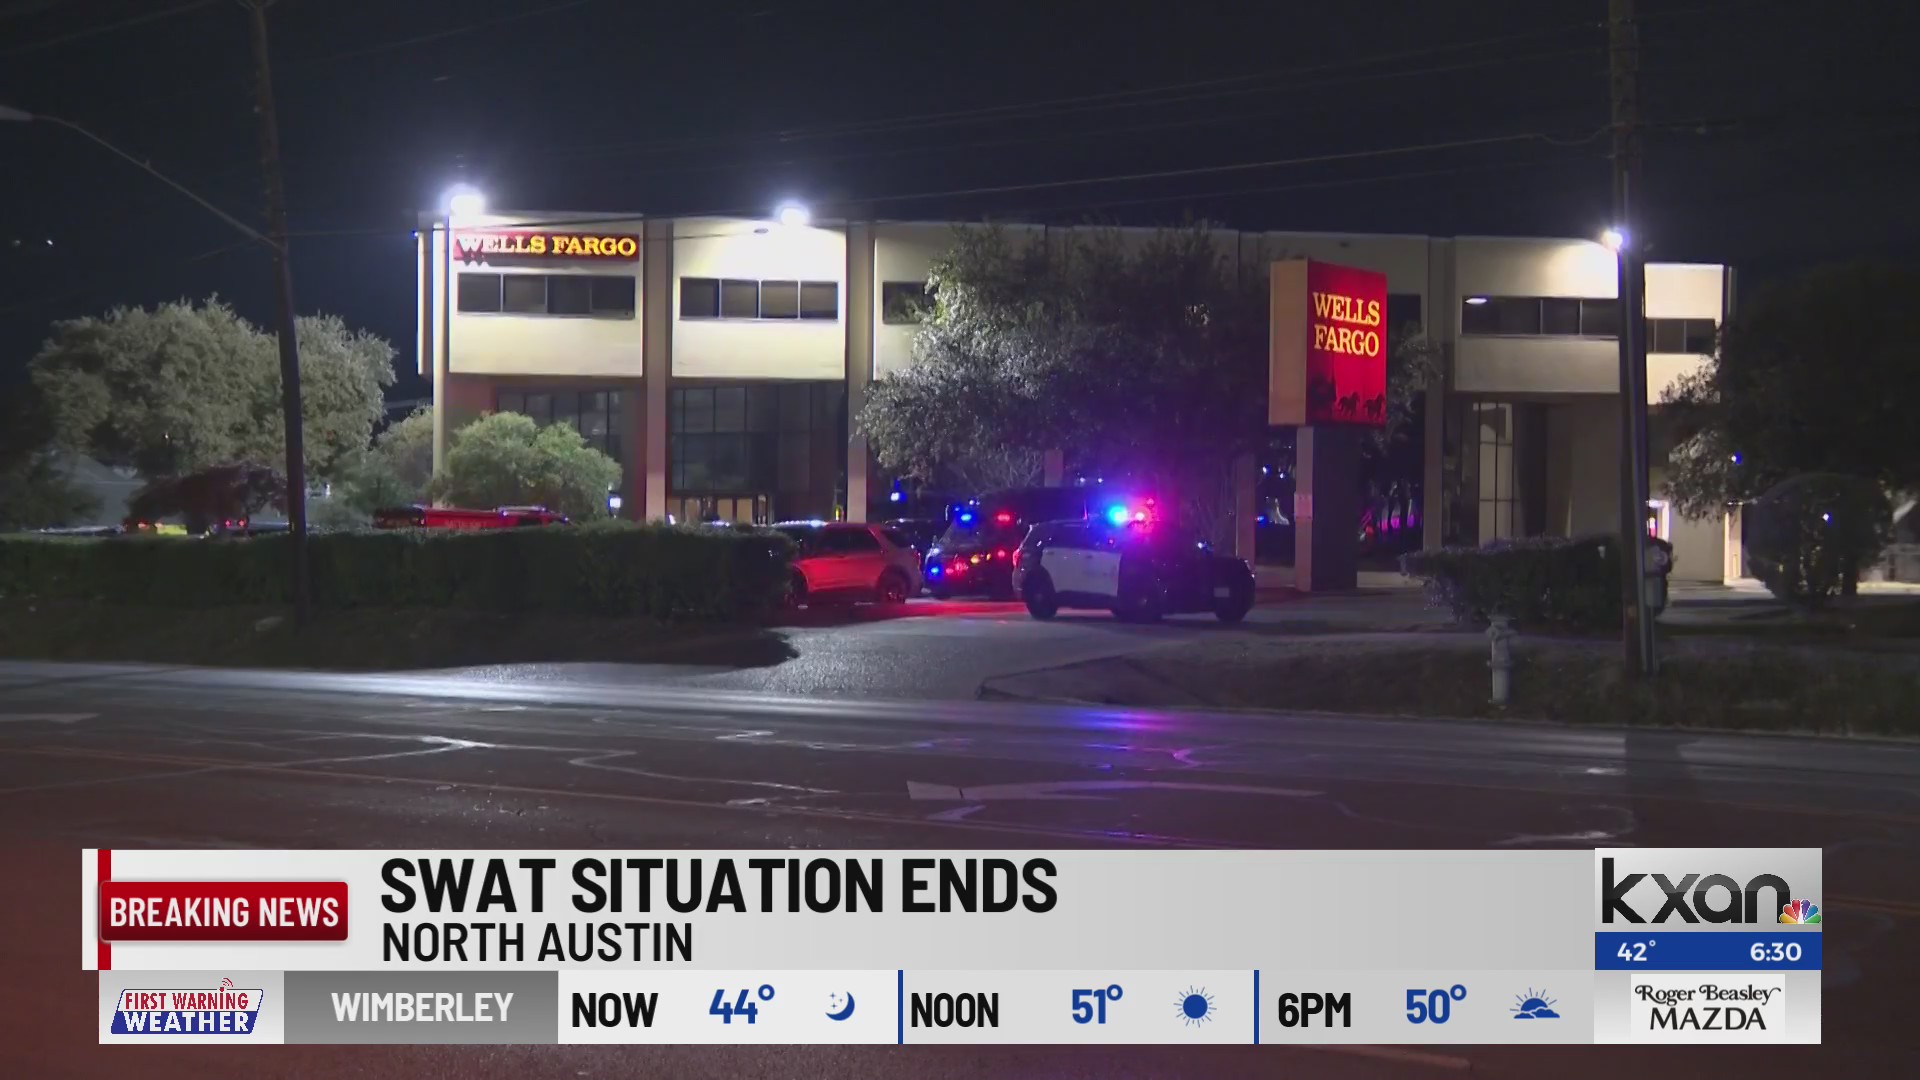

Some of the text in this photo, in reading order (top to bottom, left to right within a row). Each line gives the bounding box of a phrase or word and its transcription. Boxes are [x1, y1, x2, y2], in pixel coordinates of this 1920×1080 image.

[455, 234, 637, 256] WELLS FARGO
[1312, 291, 1380, 327] WELLS
[1314, 324, 1379, 357] FARGO
